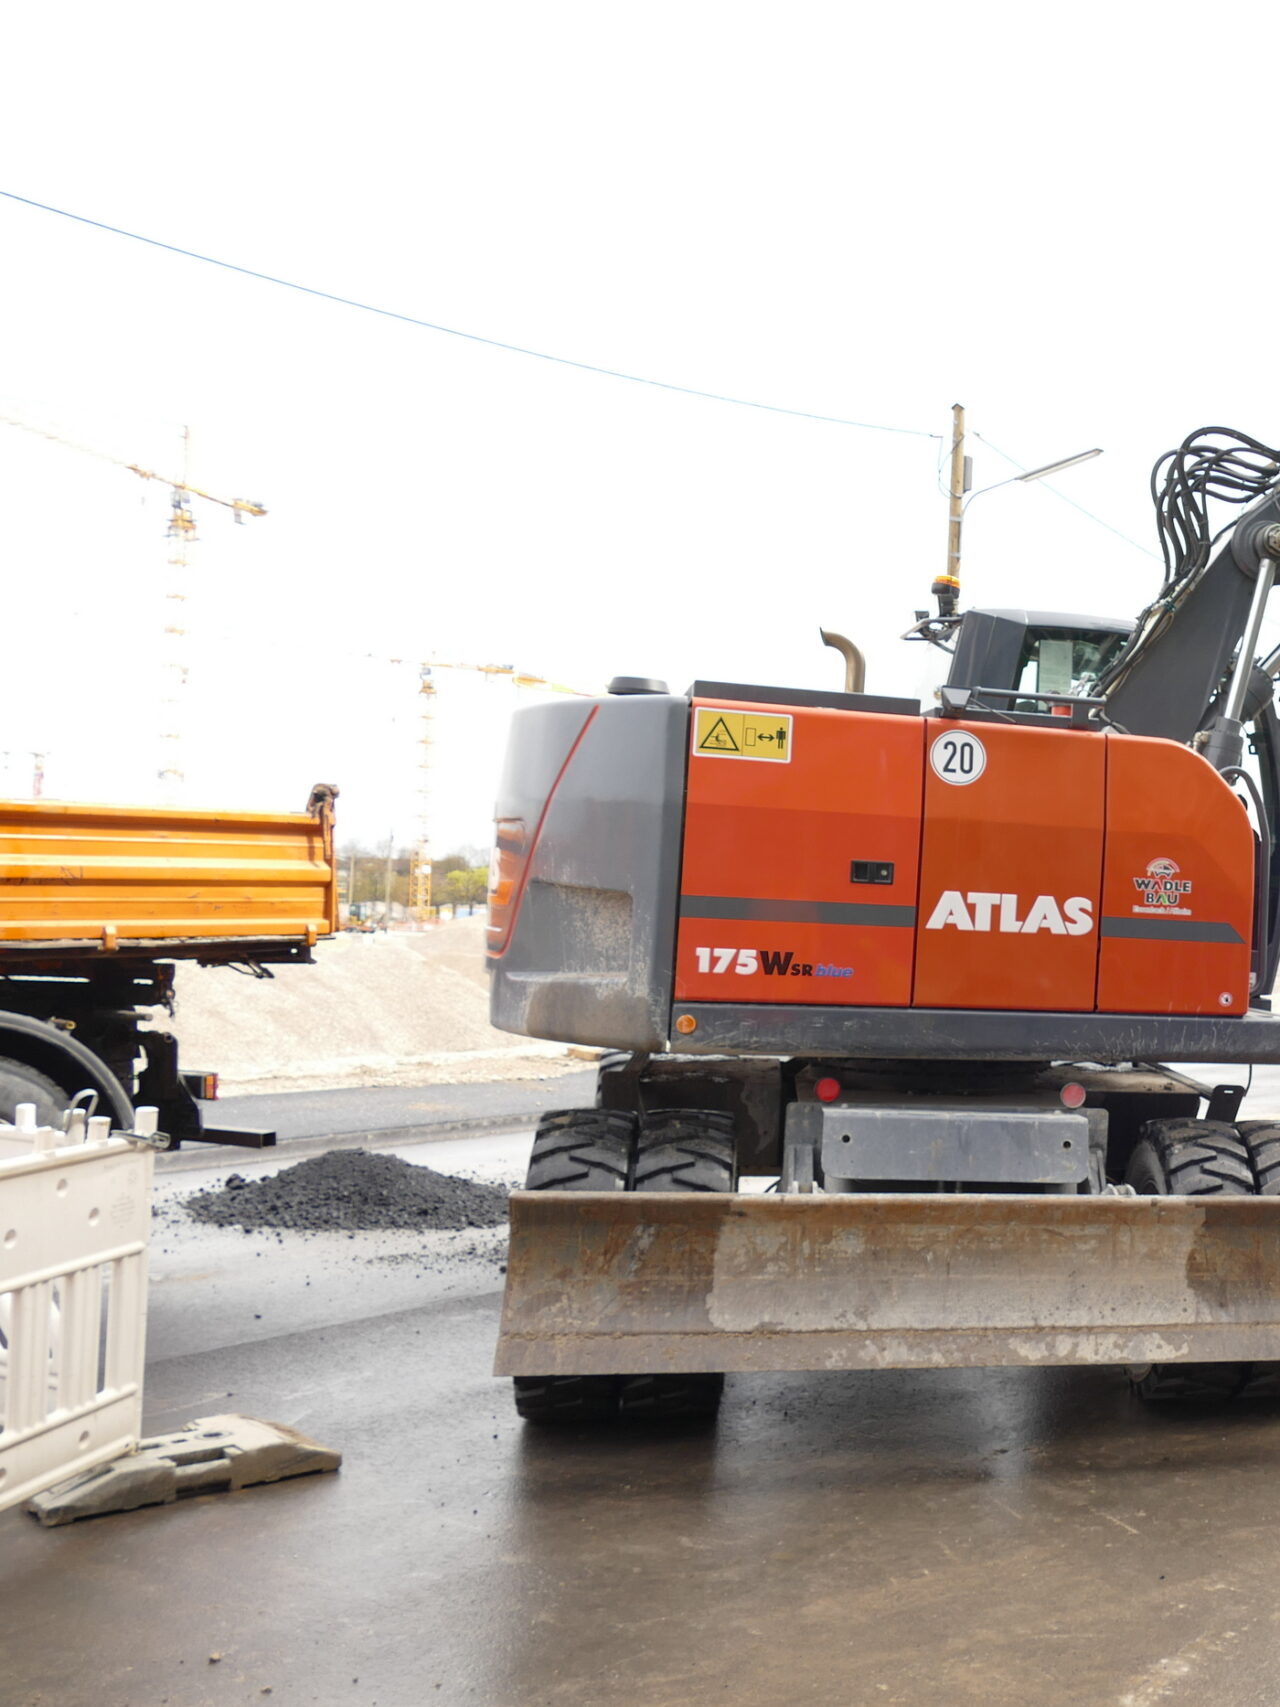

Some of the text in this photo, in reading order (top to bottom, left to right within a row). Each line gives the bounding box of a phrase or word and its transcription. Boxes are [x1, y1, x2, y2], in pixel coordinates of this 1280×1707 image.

[943, 741, 974, 774] 20
[1134, 878, 1192, 893] WADLE
[1145, 892, 1179, 905] BAU
[925, 890, 1094, 936] ATLAS
[815, 963, 854, 978] blue
